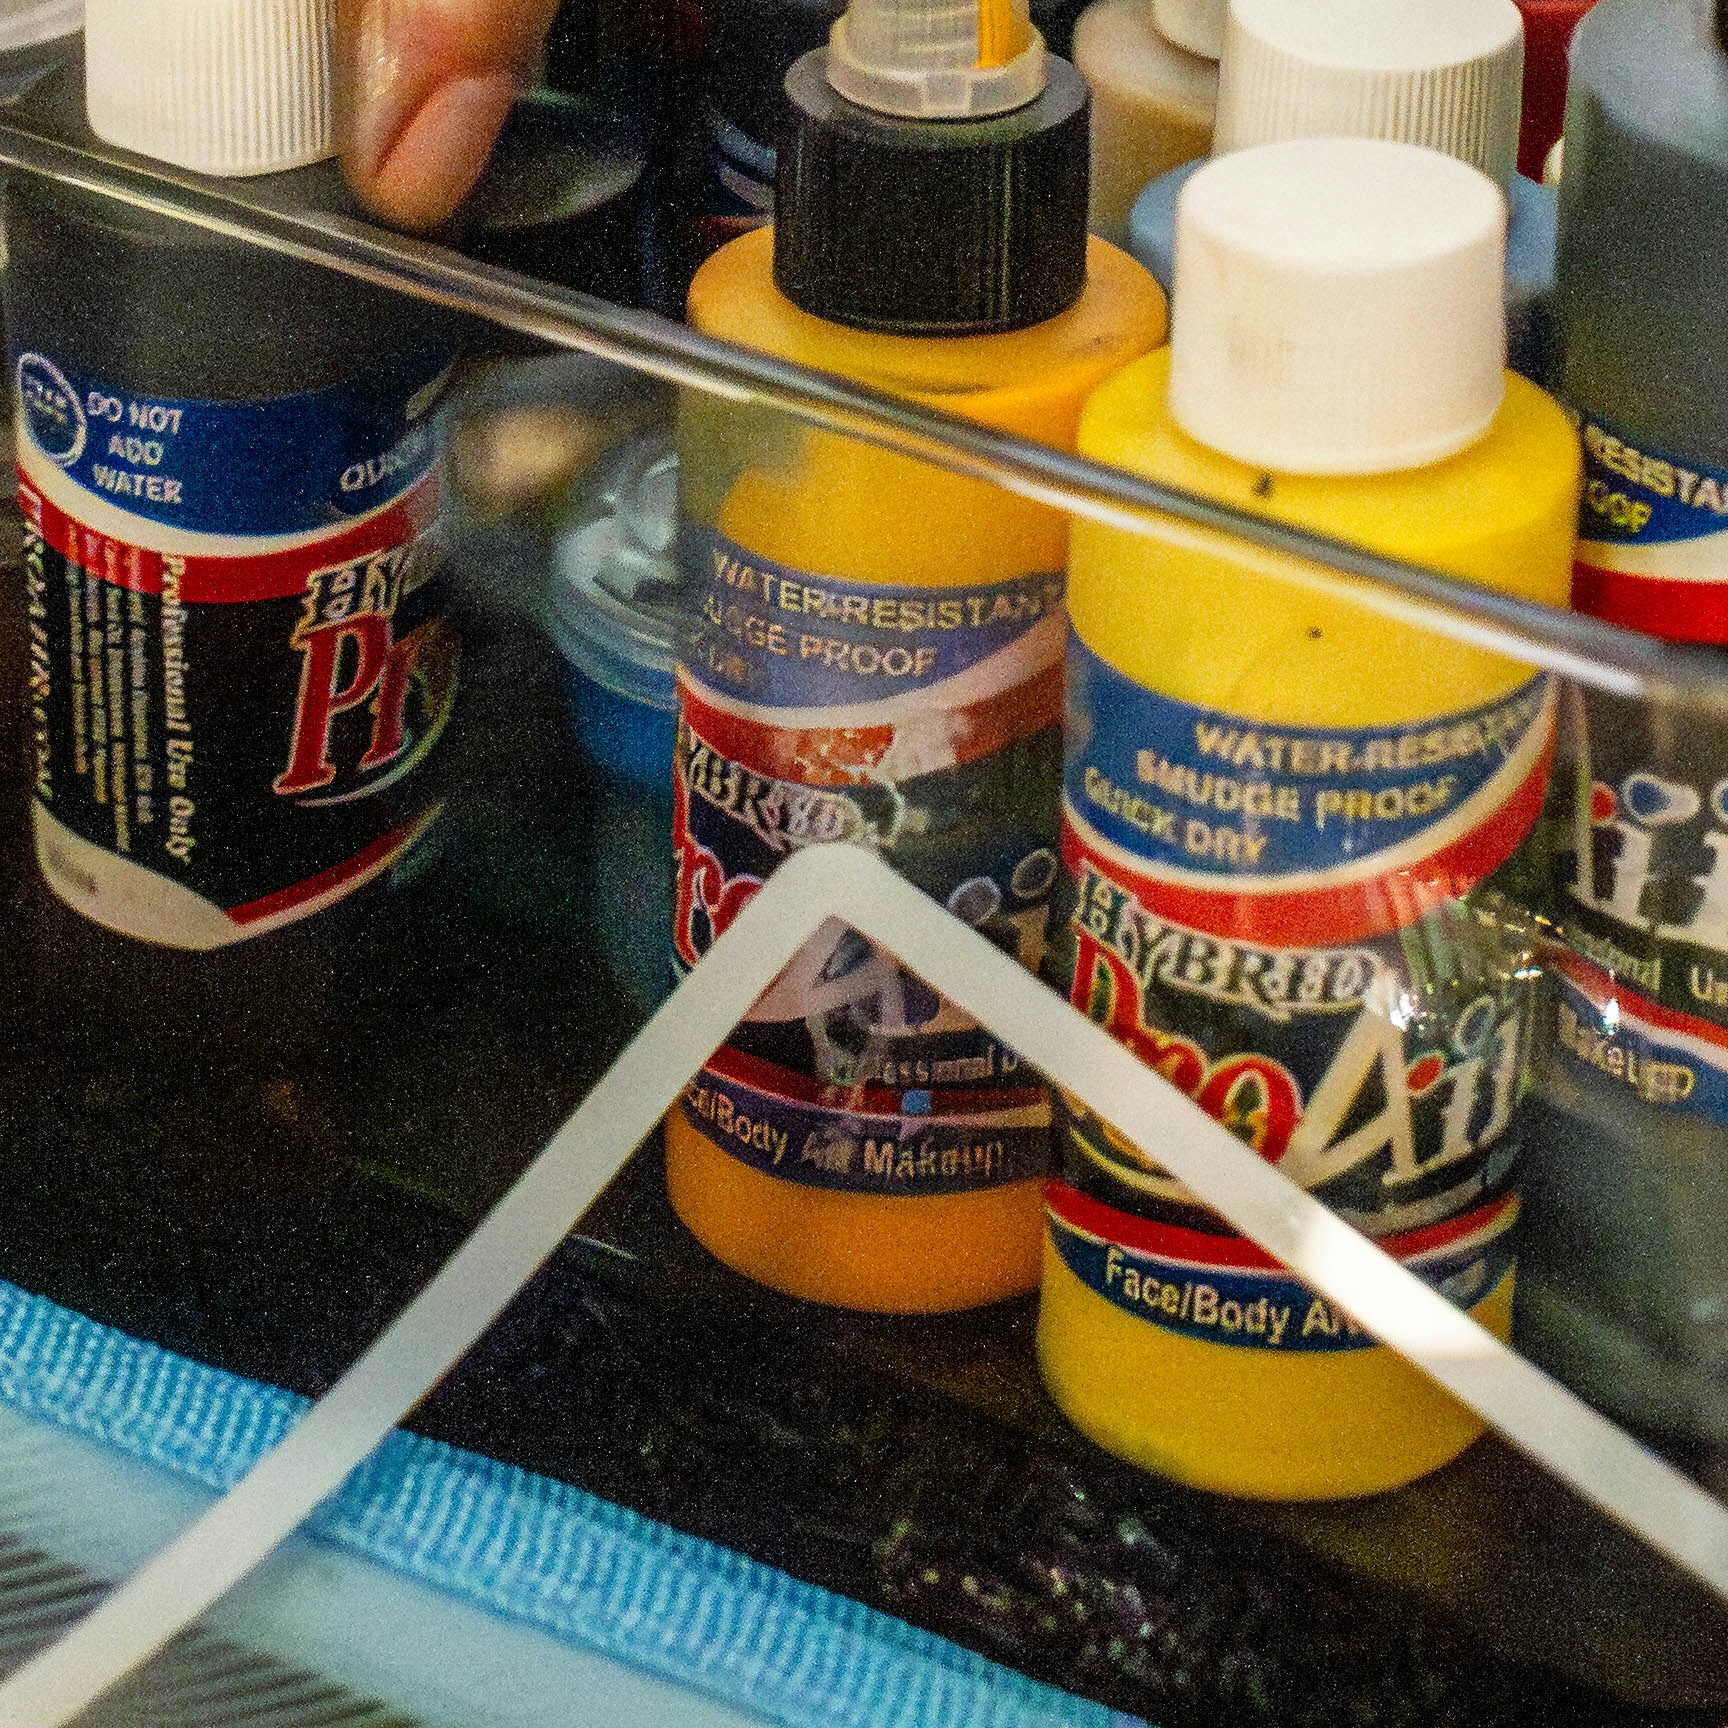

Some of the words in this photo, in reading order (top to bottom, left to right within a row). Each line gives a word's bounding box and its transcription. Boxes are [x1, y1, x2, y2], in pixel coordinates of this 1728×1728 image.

[86, 390, 123, 424] DO
[128, 400, 184, 434] NOT
[108, 433, 164, 466] ADD
[91, 463, 184, 505] WATER
[160, 555, 192, 730] Professional
[799, 632, 938, 679] PROOF
[166, 738, 193, 790] Use
[1135, 749, 1301, 818] SMUDGE
[1315, 774, 1457, 830] PROOF
[163, 796, 197, 864] Only
[1082, 765, 1176, 844] QUICK
[1183, 824, 1268, 865] DRY
[1104, 1248, 1290, 1346] Face/Body
